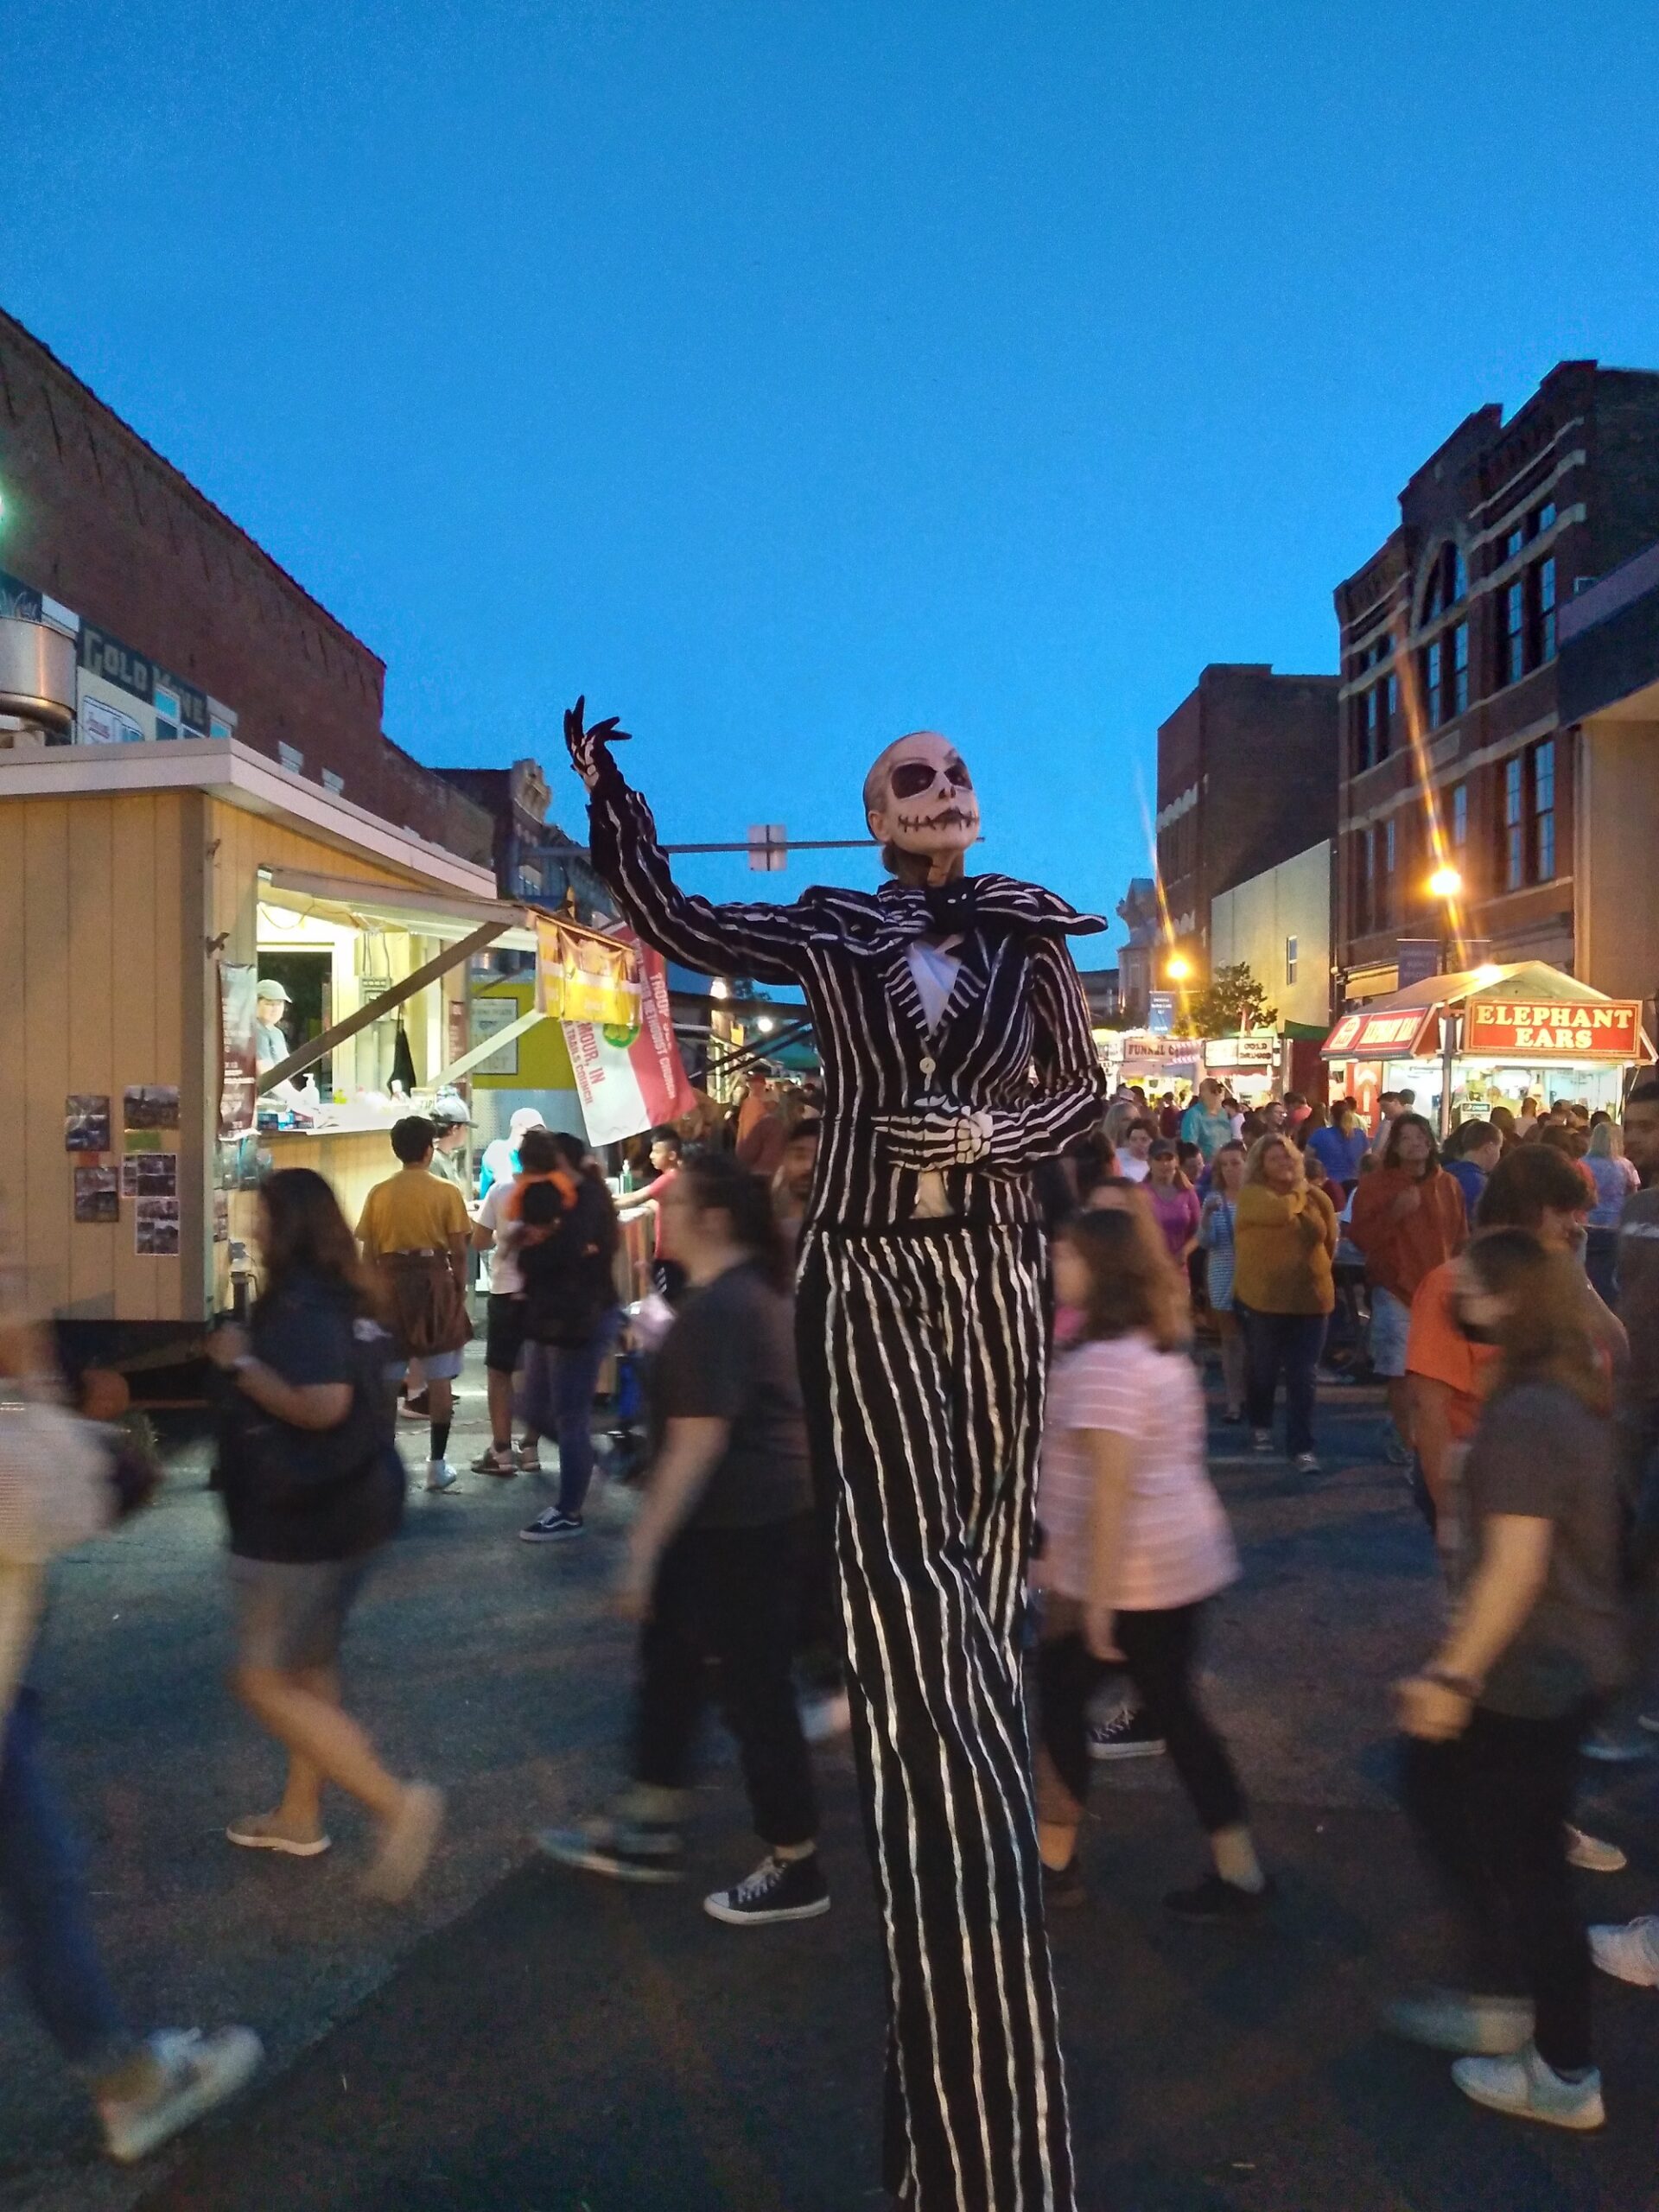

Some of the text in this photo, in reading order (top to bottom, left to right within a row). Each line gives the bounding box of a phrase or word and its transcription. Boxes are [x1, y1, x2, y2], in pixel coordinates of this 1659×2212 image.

[84, 628, 148, 691] GOLD
[1476, 1005, 1633, 1029] ELEPHANT
[1515, 1028, 1592, 1049] EARS
[577, 1021, 606, 1084] MOUR, IN
